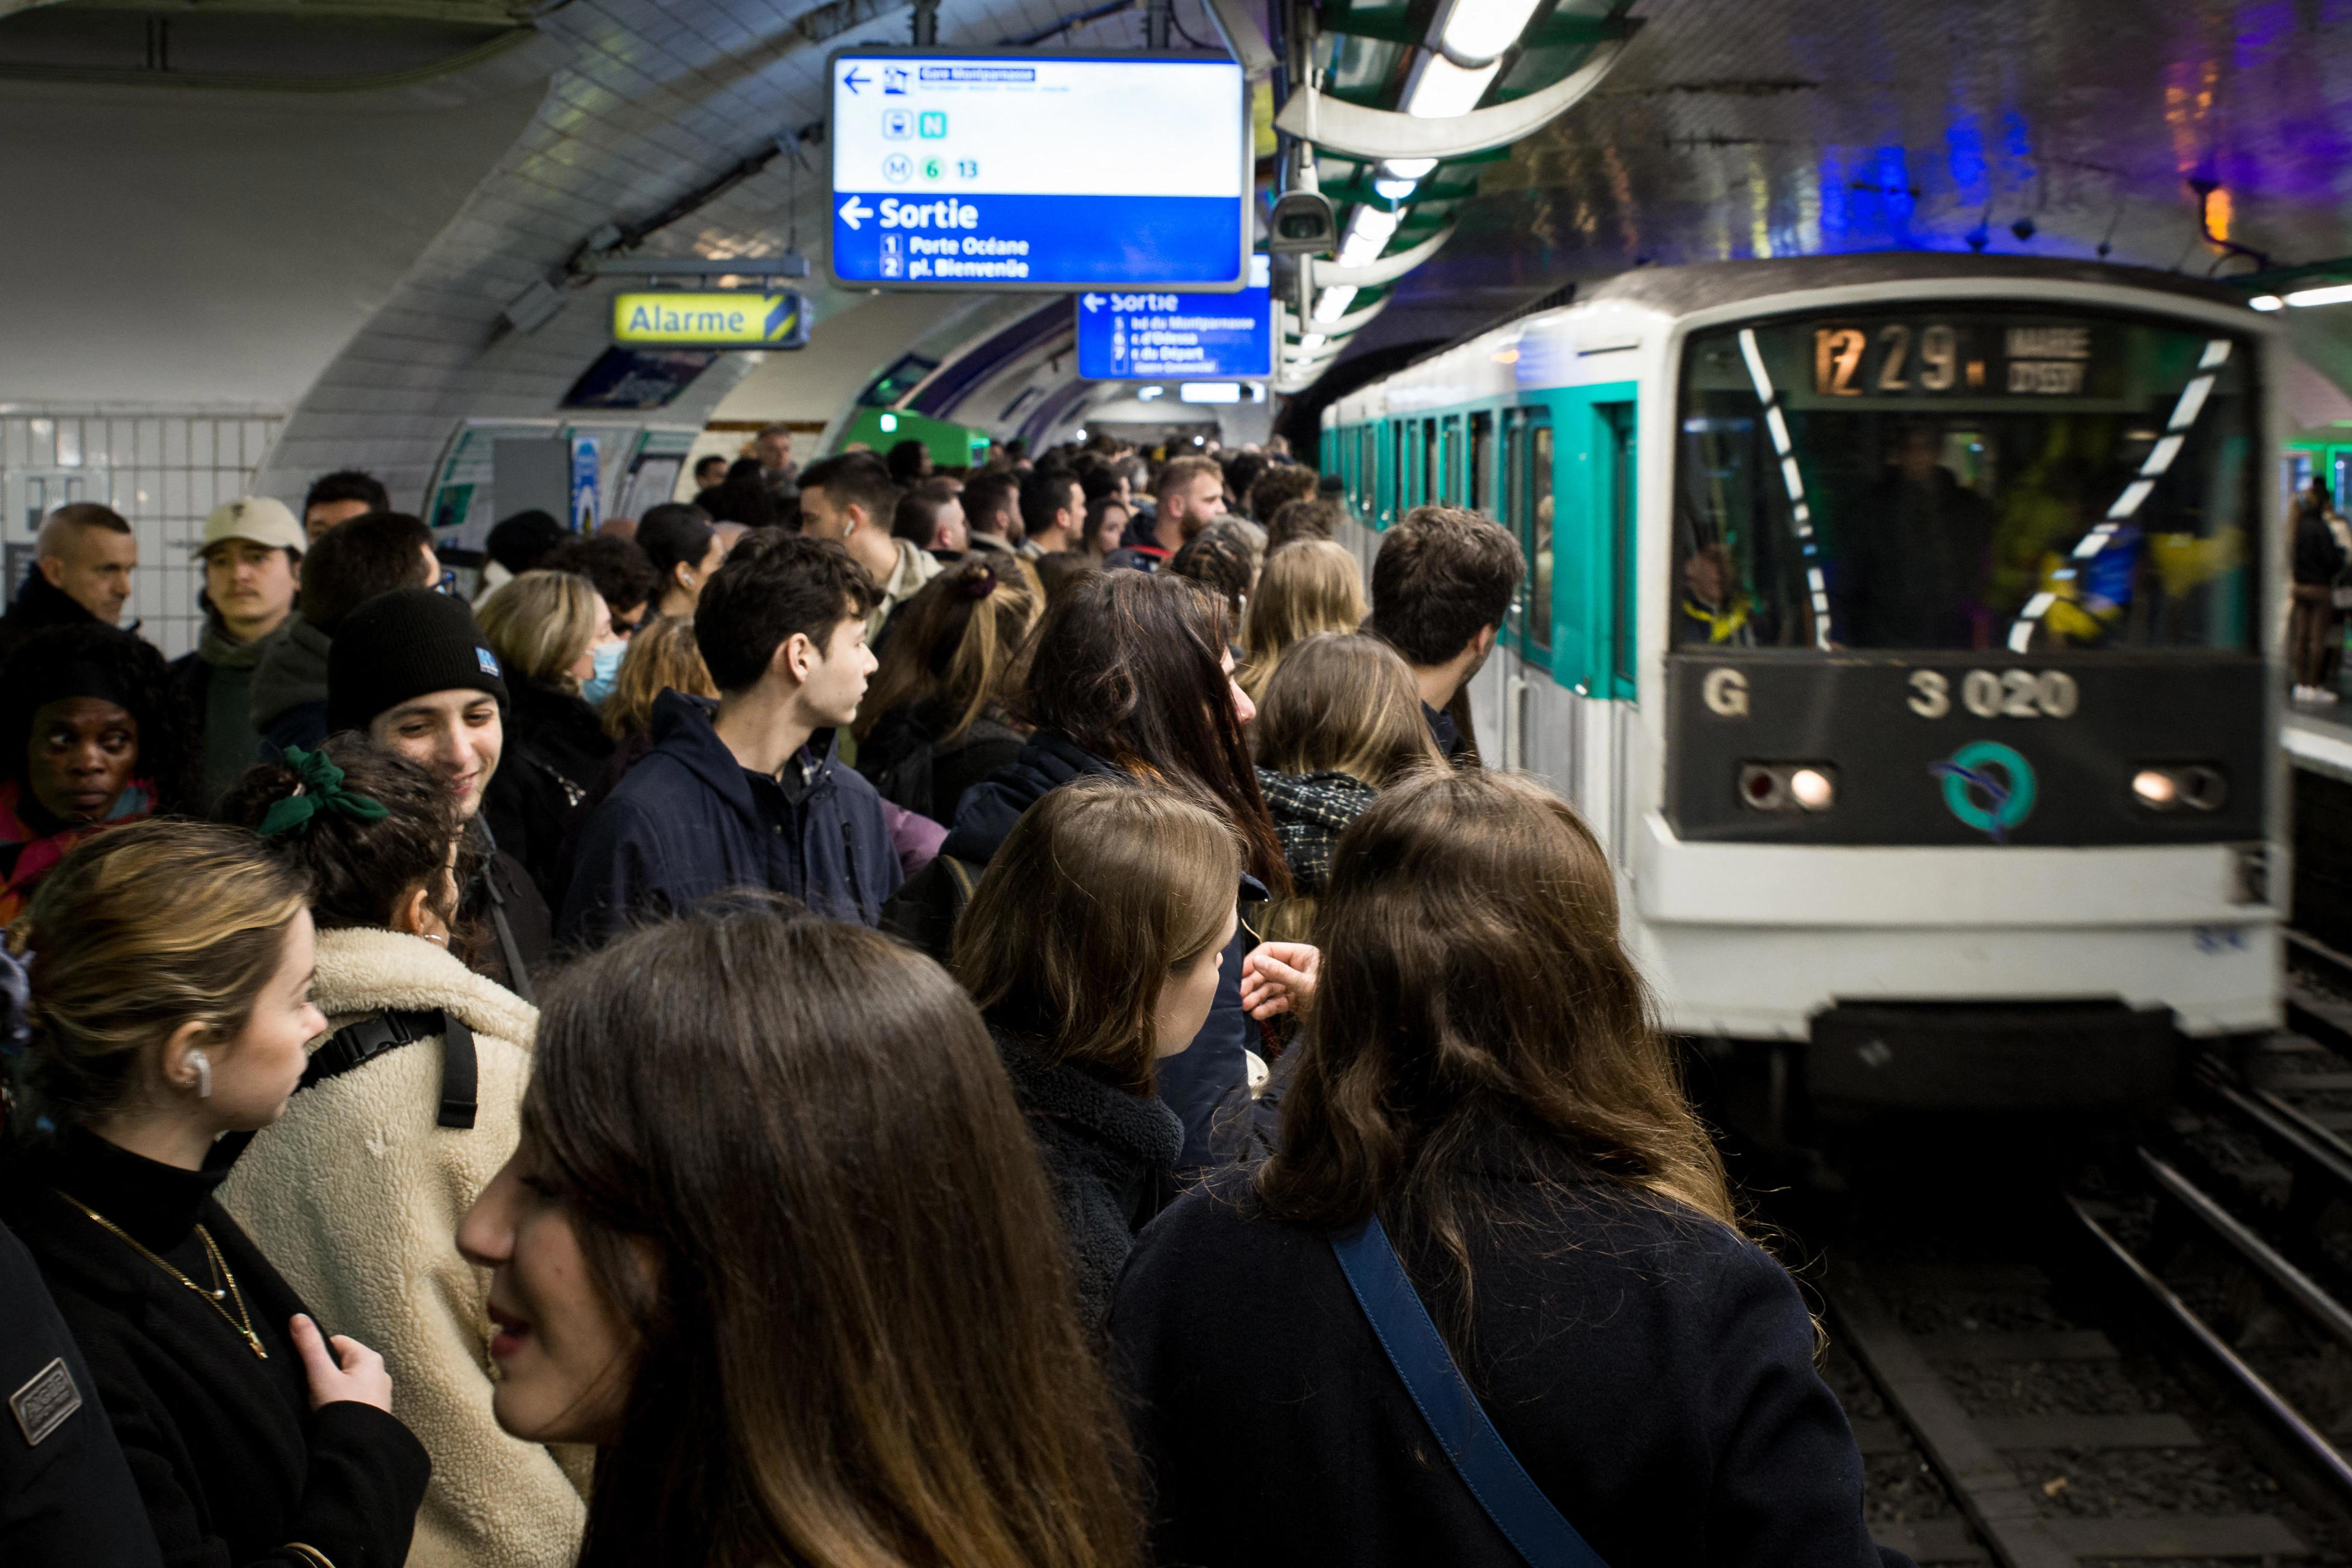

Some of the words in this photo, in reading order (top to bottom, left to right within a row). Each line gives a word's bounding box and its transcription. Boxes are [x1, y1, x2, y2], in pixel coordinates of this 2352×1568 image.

[926, 116, 943, 135] N
[926, 160, 939, 178] 6
[957, 160, 978, 178] 13
[879, 197, 978, 229] Sortie
[885, 236, 896, 254] 1
[910, 236, 959, 254] Porte
[962, 236, 1029, 255] Océane
[885, 257, 898, 277] 2
[909, 257, 933, 280] pl.
[1111, 293, 1178, 311] Sortie
[630, 305, 745, 332] Alarme
[1877, 324, 1956, 391] 29
[1702, 669, 1750, 717] G
[1962, 669, 2080, 720] 020
